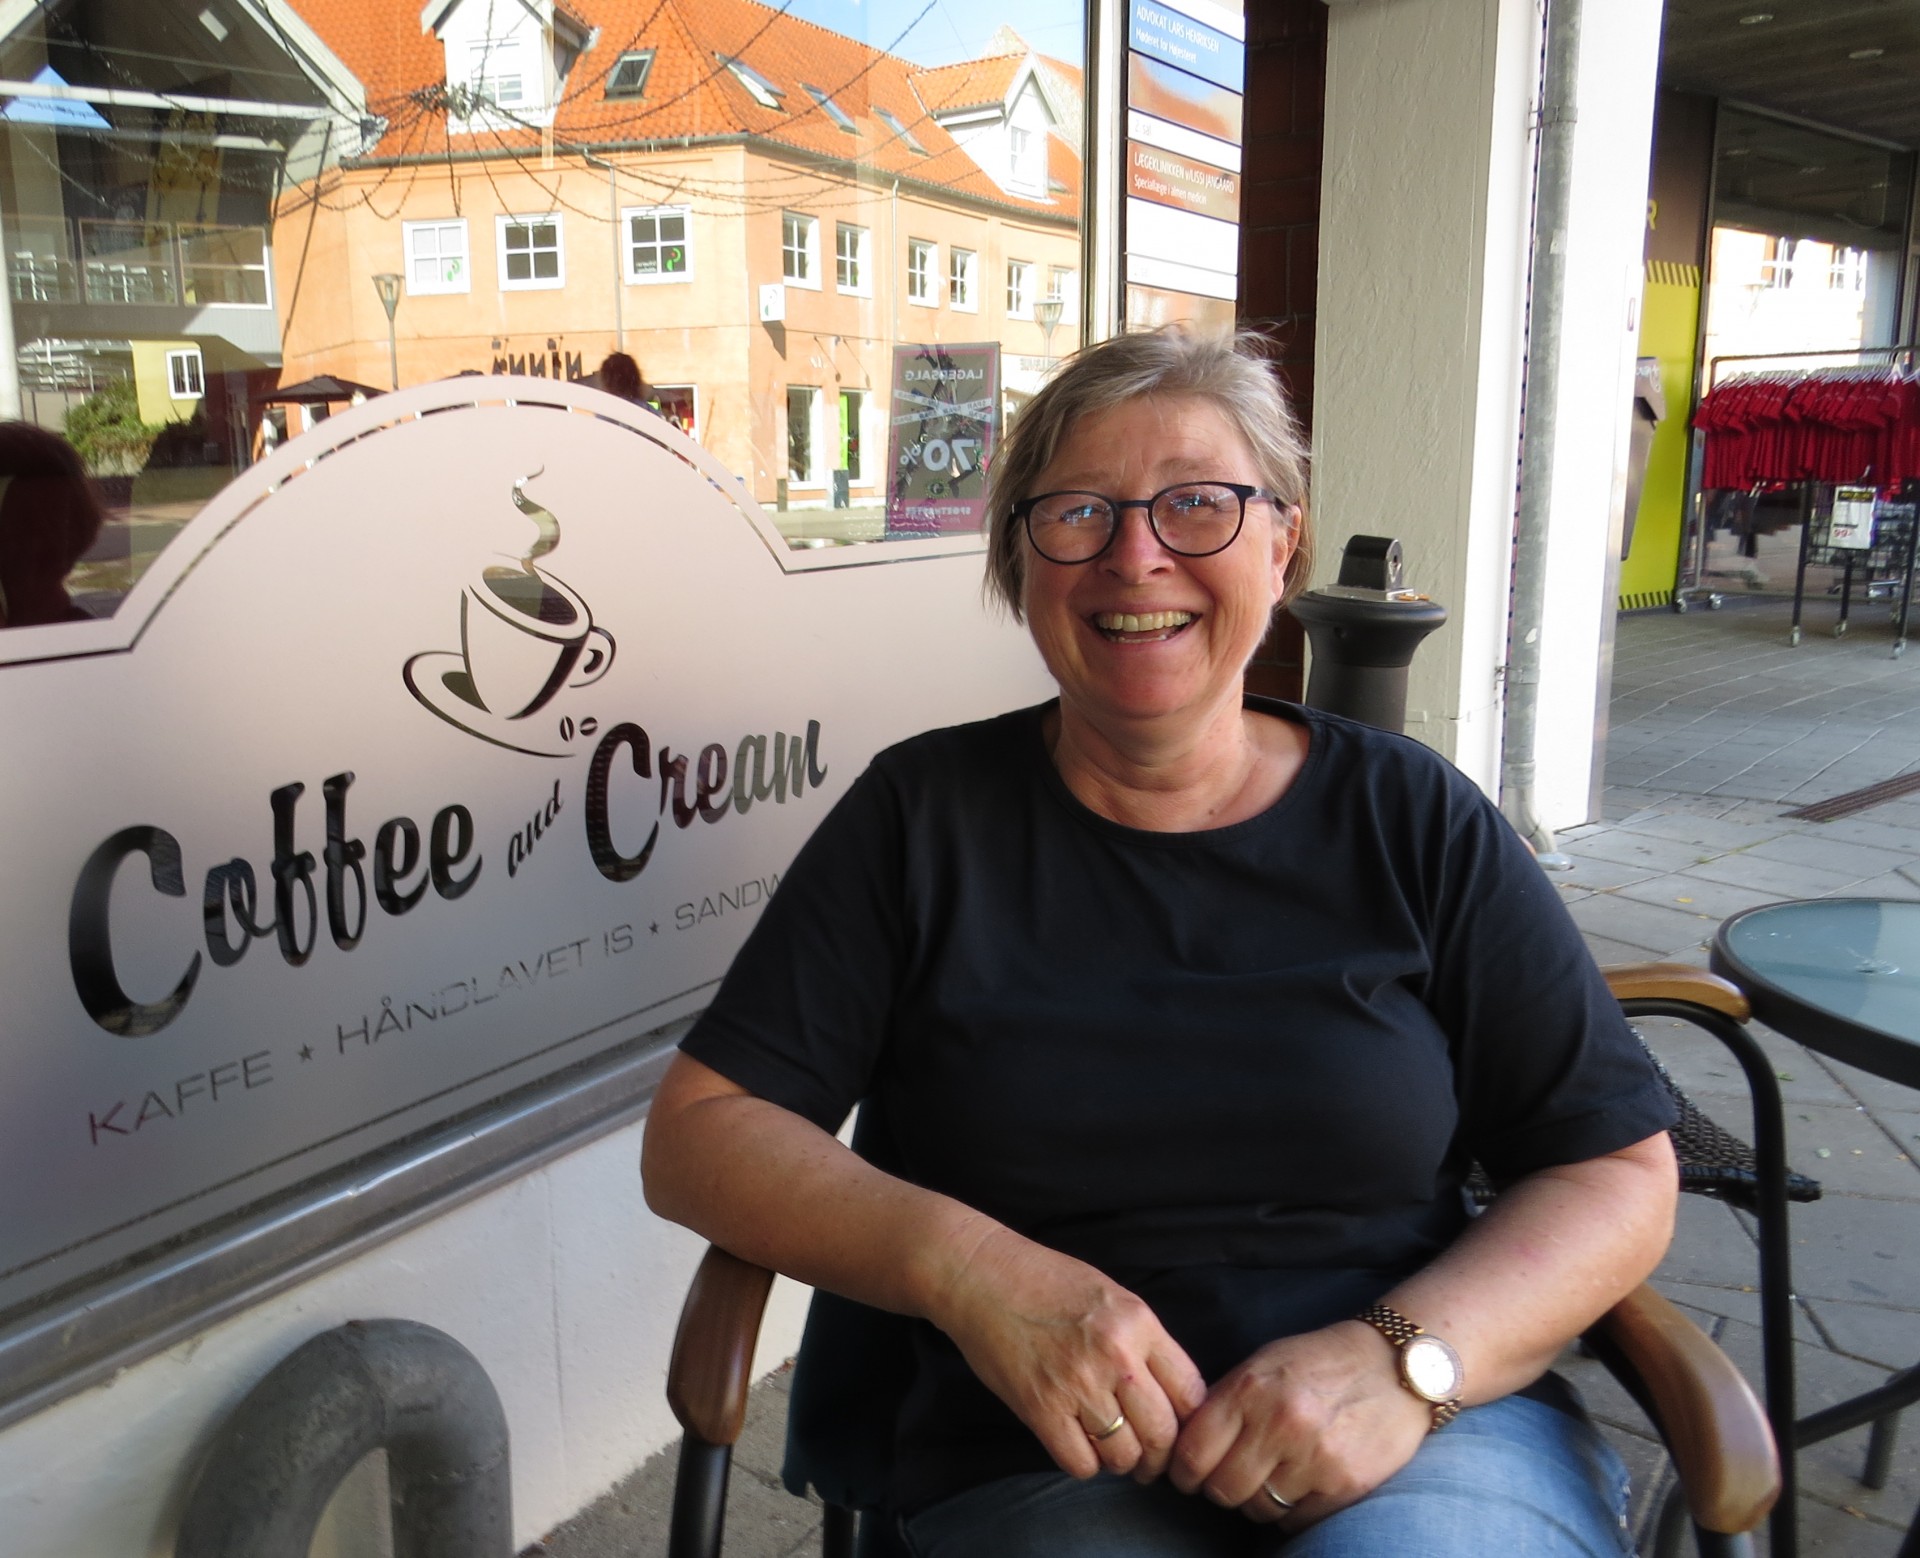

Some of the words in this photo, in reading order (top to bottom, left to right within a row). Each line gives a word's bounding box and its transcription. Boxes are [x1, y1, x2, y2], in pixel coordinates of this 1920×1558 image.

[1136, 5, 1167, 31] ADVOKAT
[1168, 20, 1185, 39] LARS
[1186, 28, 1220, 54] HENRIKSEN
[1134, 151, 1184, 179] LÆGEKLINIKKEN
[69, 771, 483, 1038] Coffee
[506, 778, 565, 878] and
[584, 719, 828, 883] Cream
[89, 1050, 274, 1146] KAFFE
[336, 938, 590, 1055] HÅNDLAVET
[602, 923, 634, 958] IS
